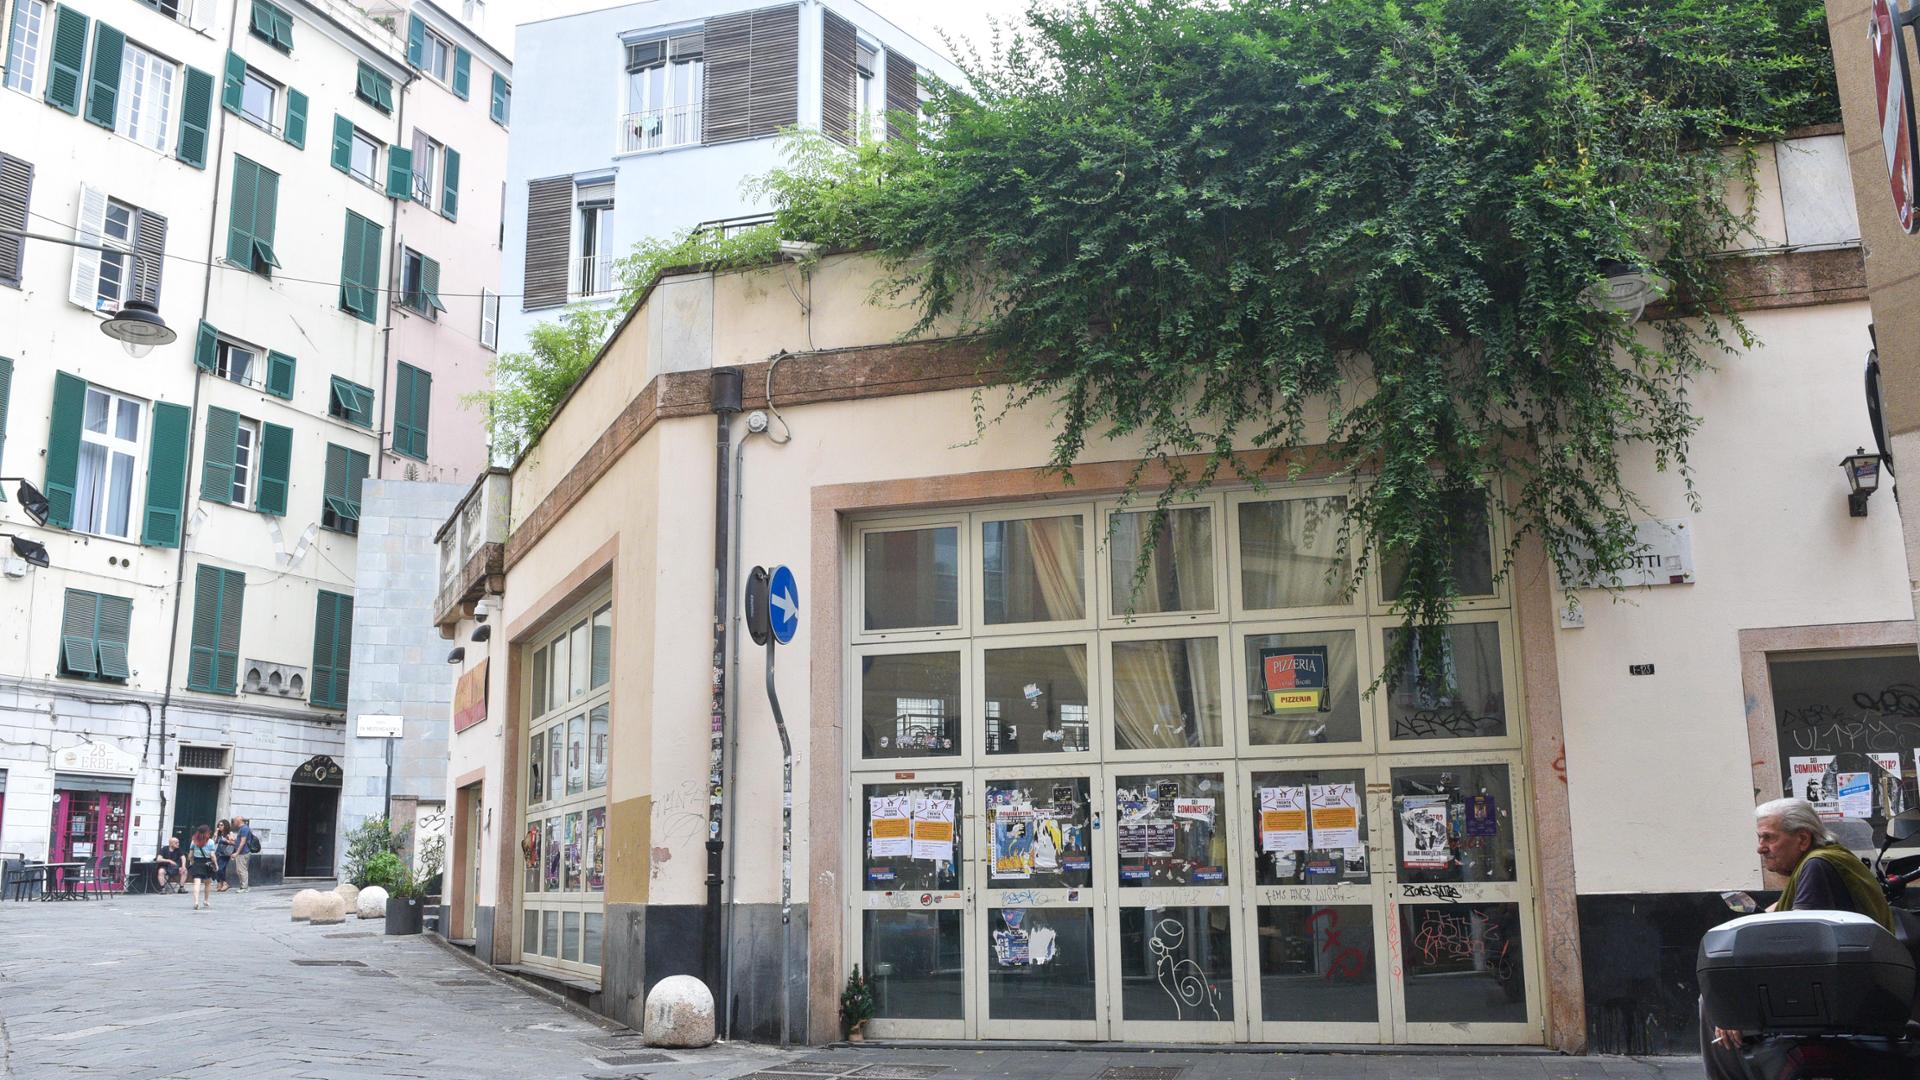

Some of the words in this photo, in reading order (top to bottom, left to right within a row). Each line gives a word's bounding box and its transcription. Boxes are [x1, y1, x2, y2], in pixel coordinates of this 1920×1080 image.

[1273, 658, 1317, 674] PIZZERIA
[1280, 695, 1312, 704] PIZZERIA
[81, 756, 114, 770] ERBE
